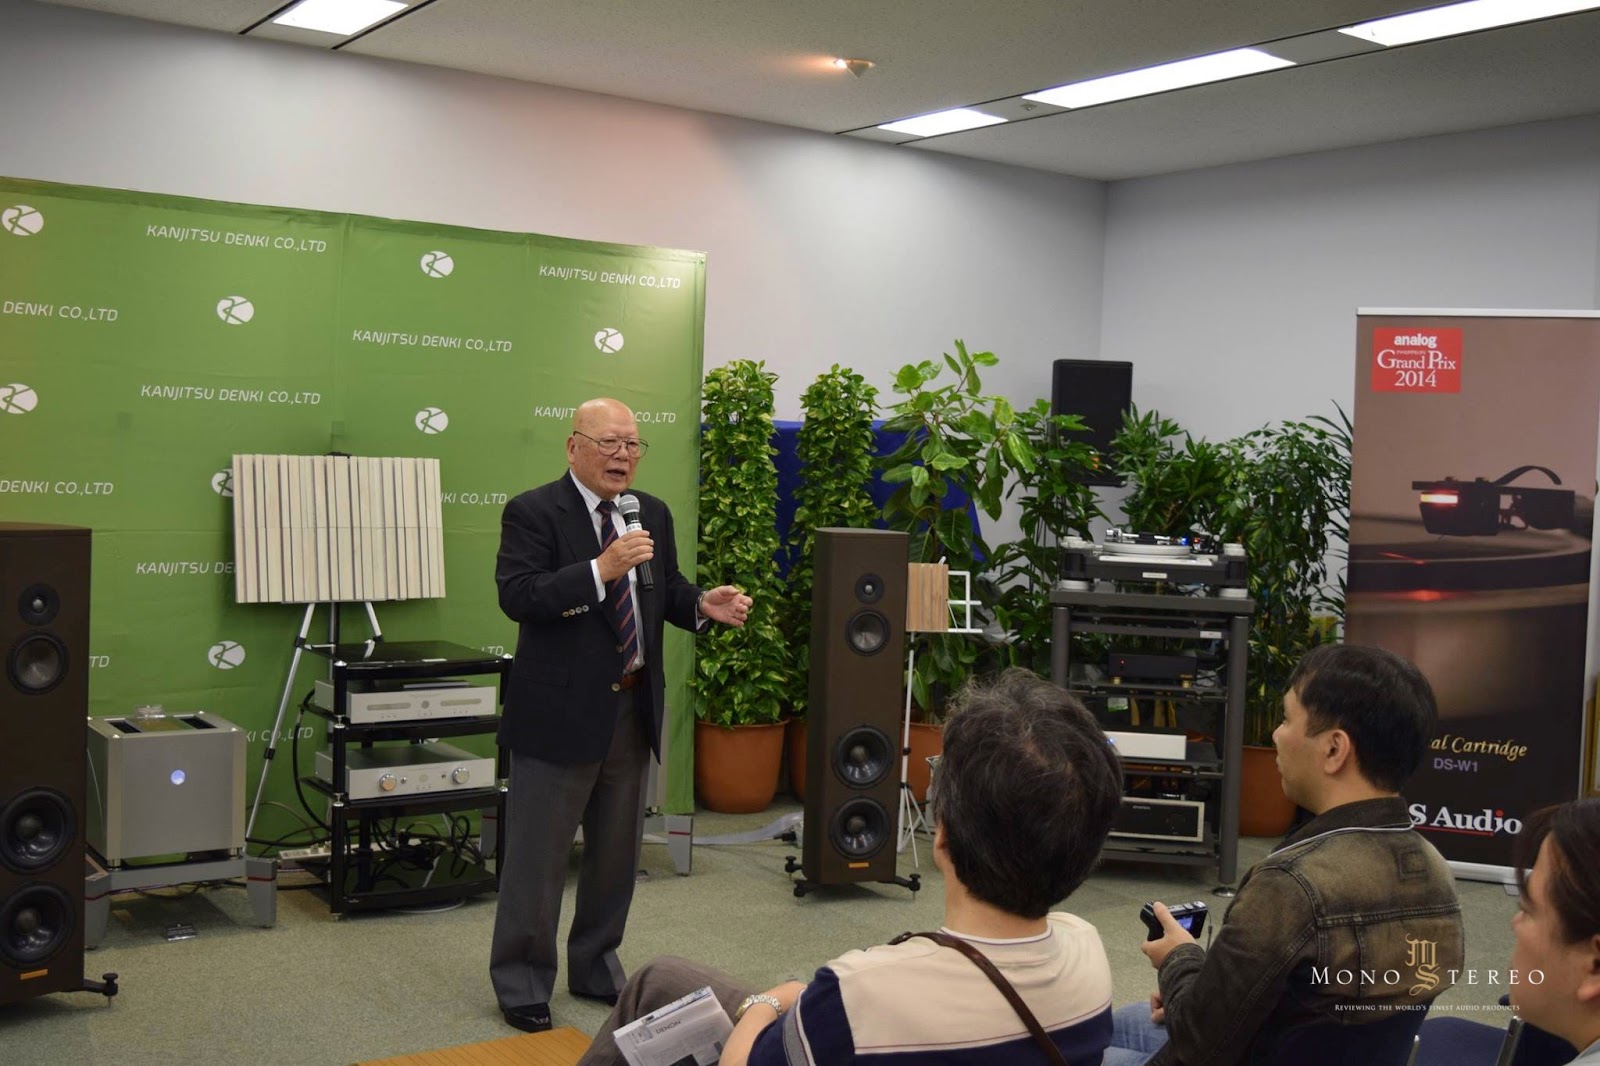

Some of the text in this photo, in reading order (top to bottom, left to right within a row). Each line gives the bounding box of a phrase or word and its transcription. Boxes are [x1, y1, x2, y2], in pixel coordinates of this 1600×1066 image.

[146, 224, 221, 243] KANJITSU
[224, 232, 270, 248] DENKI
[539, 265, 598, 281] KANJITSU
[600, 272, 636, 285] DENKI
[3, 301, 54, 317] DENKI
[352, 329, 418, 346] KANJITSU
[421, 335, 462, 349] DENKI
[1394, 333, 1438, 349] analog
[1377, 349, 1456, 370] Grand Prix
[1394, 370, 1437, 387] 2014
[140, 385, 215, 400] KANJITSU
[219, 388, 264, 402] DENKI
[534, 406, 577, 420] KANJIT
[0, 480, 49, 493] DENKI
[136, 562, 210, 577] KANJITSU
[1451, 736, 1528, 761] Cartridge
[1433, 757, 1479, 772] DS-W1
[1429, 806, 1523, 834] Audio
